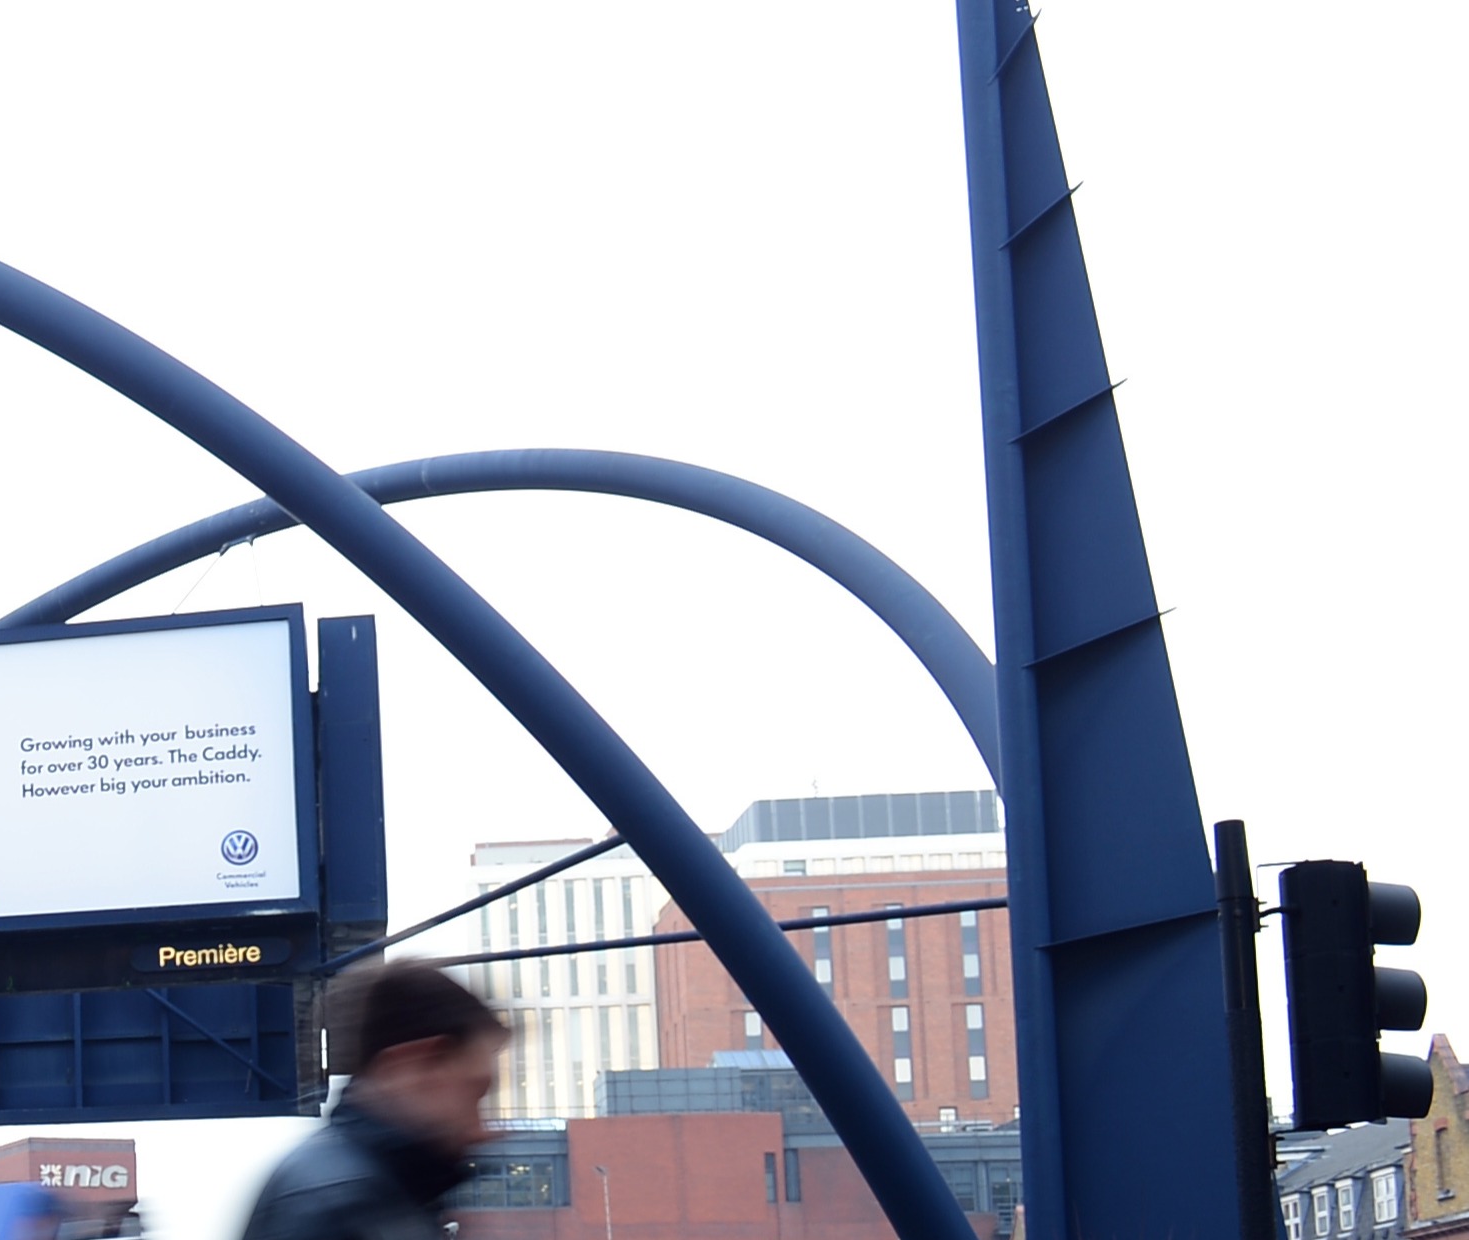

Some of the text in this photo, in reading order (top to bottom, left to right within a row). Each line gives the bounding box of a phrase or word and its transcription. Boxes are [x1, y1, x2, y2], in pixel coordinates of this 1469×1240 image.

[20, 723, 256, 752] Growing with your business
[21, 743, 262, 775] for over 30 years. The Caddy.
[22, 769, 251, 798] However big your ambition.
[158, 943, 261, 967] Première
